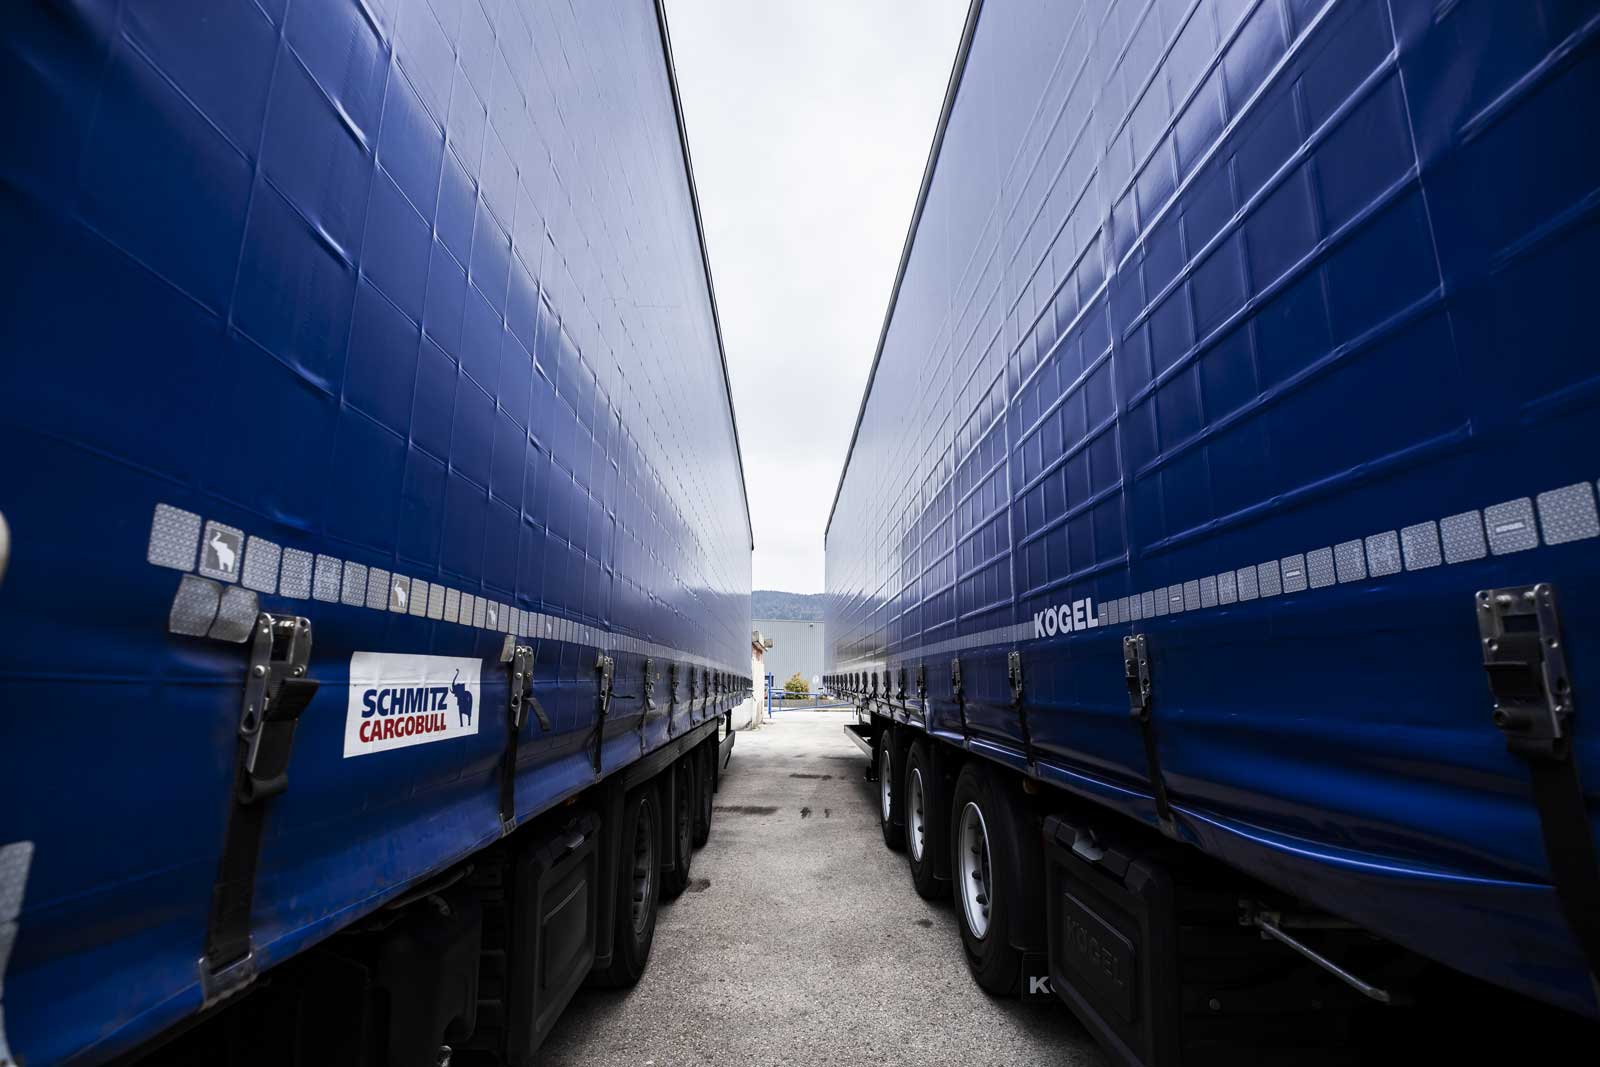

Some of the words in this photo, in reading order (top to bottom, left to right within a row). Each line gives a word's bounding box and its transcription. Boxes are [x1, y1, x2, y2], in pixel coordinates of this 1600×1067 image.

[1034, 597, 1099, 639] KÖGEL
[361, 687, 449, 718] SCHMITZ
[359, 713, 447, 743] CARGOBULL
[1029, 976, 1056, 994] K
